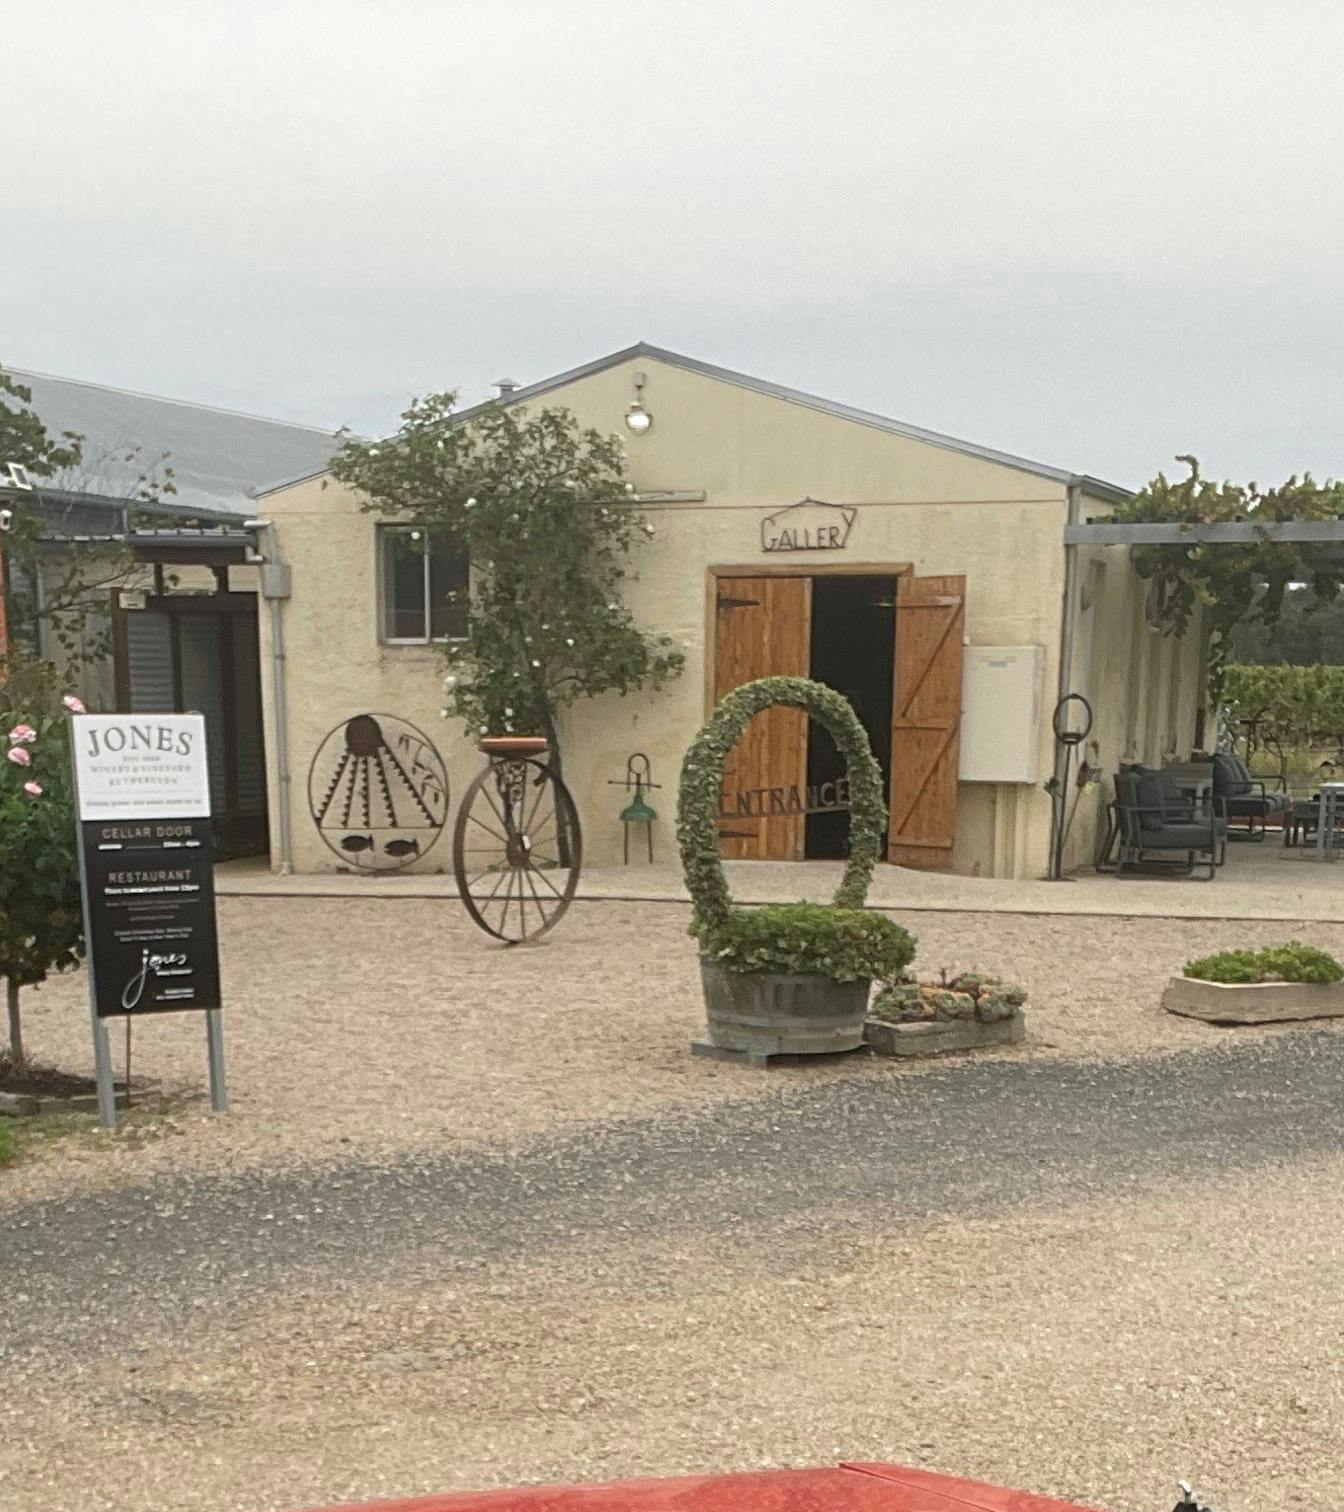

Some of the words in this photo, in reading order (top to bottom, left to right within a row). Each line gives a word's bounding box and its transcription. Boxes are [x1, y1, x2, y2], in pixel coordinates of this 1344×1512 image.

[761, 508, 857, 551] GALLERY
[88, 725, 192, 757] JONES
[102, 827, 152, 839] CELLAR
[156, 825, 192, 837] DOOR
[108, 869, 192, 884] RESTAURANT
[122, 948, 187, 1009] jones
